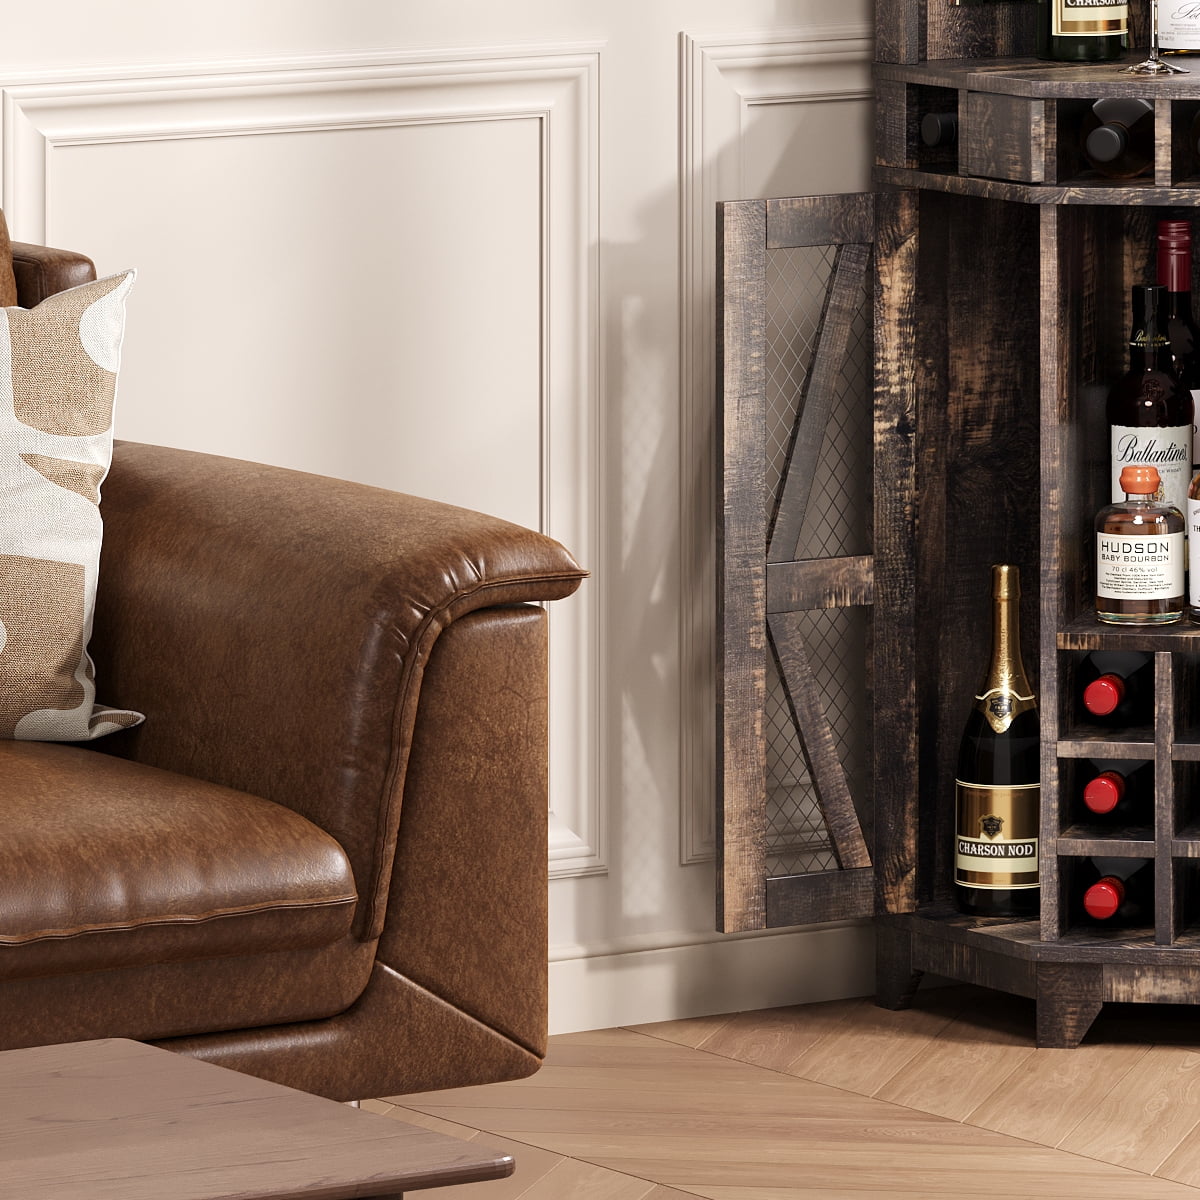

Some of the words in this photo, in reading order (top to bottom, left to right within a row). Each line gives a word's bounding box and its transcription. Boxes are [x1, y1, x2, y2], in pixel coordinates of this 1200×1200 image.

[1101, 540, 1169, 554] HUDSON
[1101, 553, 1121, 562] BABY
[1123, 554, 1169, 563] BOURBON
[958, 841, 1005, 856] CHARSON
[1008, 844, 1033, 856] NOD
